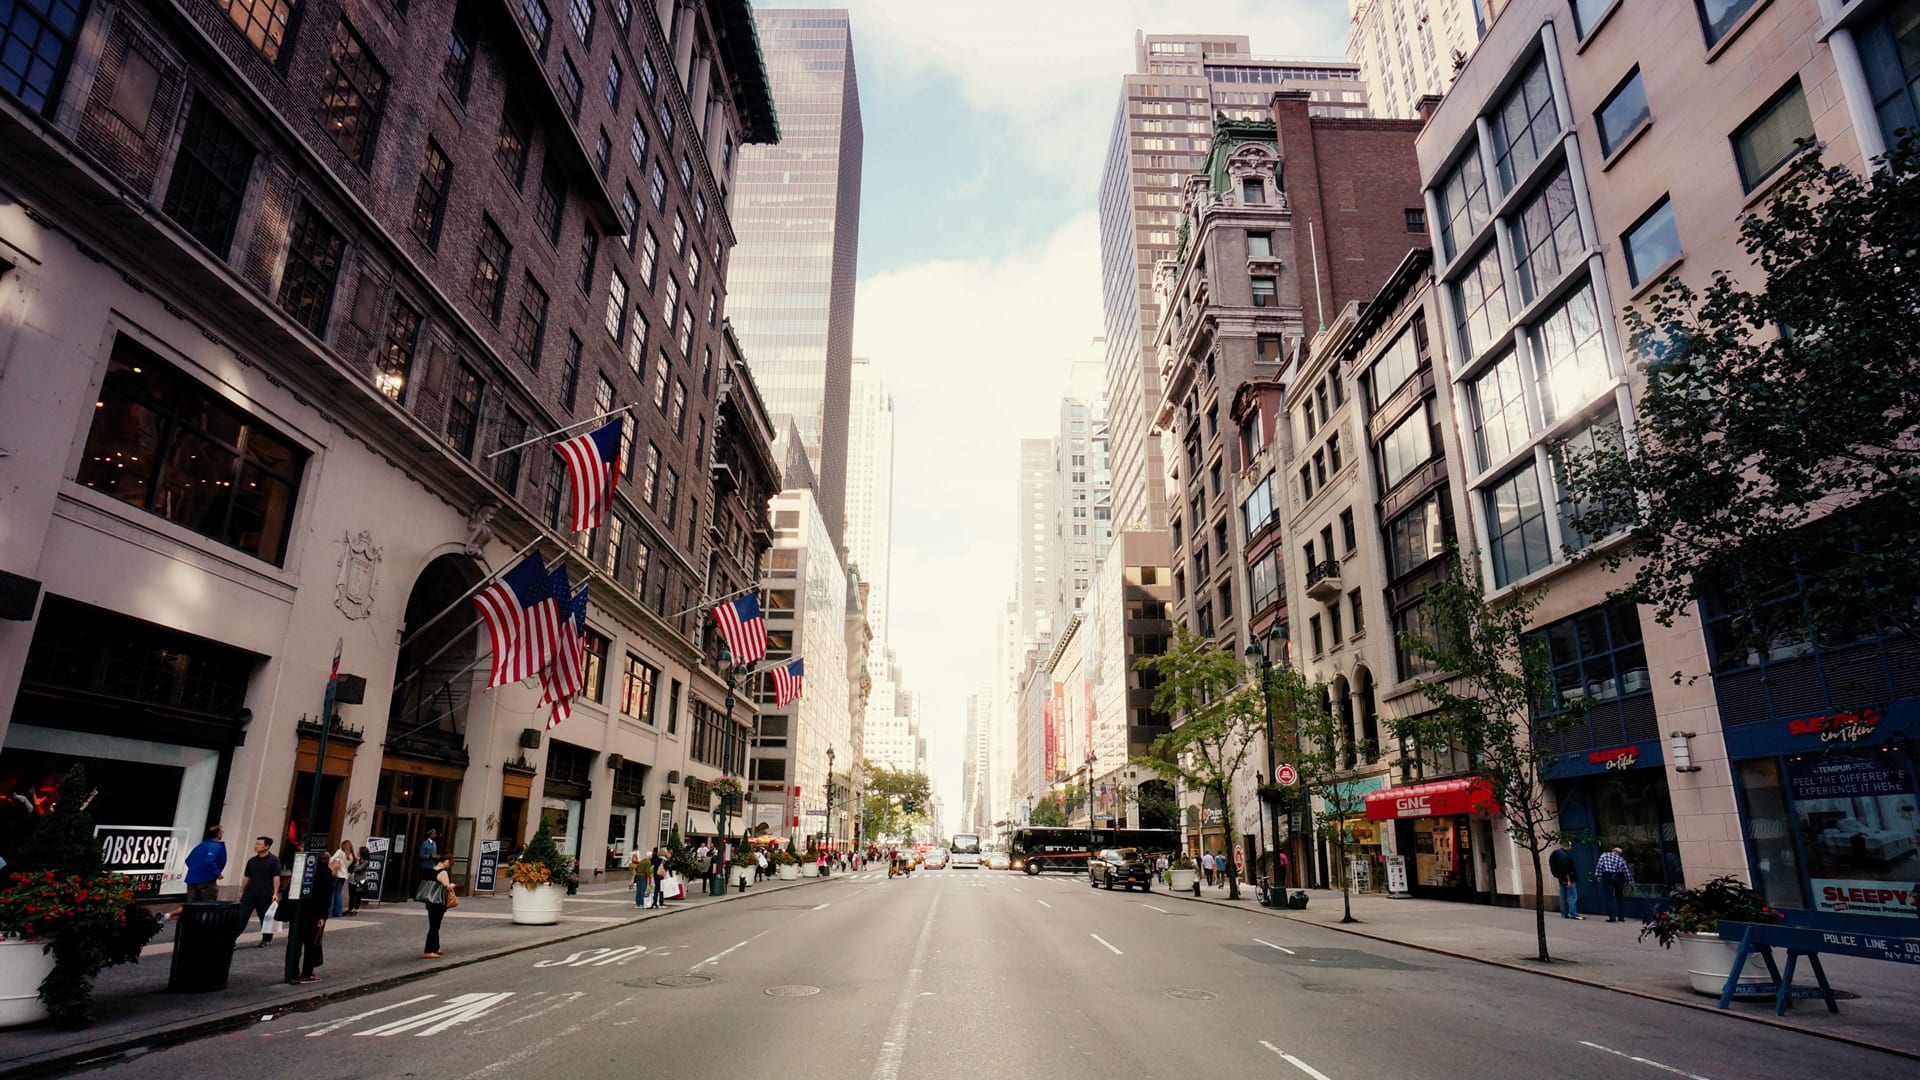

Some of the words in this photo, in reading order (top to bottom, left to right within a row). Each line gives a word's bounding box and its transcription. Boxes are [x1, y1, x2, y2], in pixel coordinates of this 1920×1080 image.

[1793, 777, 1816, 786] FEEL
[1819, 774, 1837, 784] THE
[1840, 769, 1905, 783] DIFFERENE
[1799, 784, 1859, 796] EXPERIENCE
[1861, 783, 1871, 792] IT
[1396, 796, 1432, 809] GNC
[102, 835, 179, 865] OBSESSED
[1823, 886, 1908, 905] SLEEPY
[1823, 933, 1857, 947] POLICE
[1865, 938, 1888, 950] LINE
